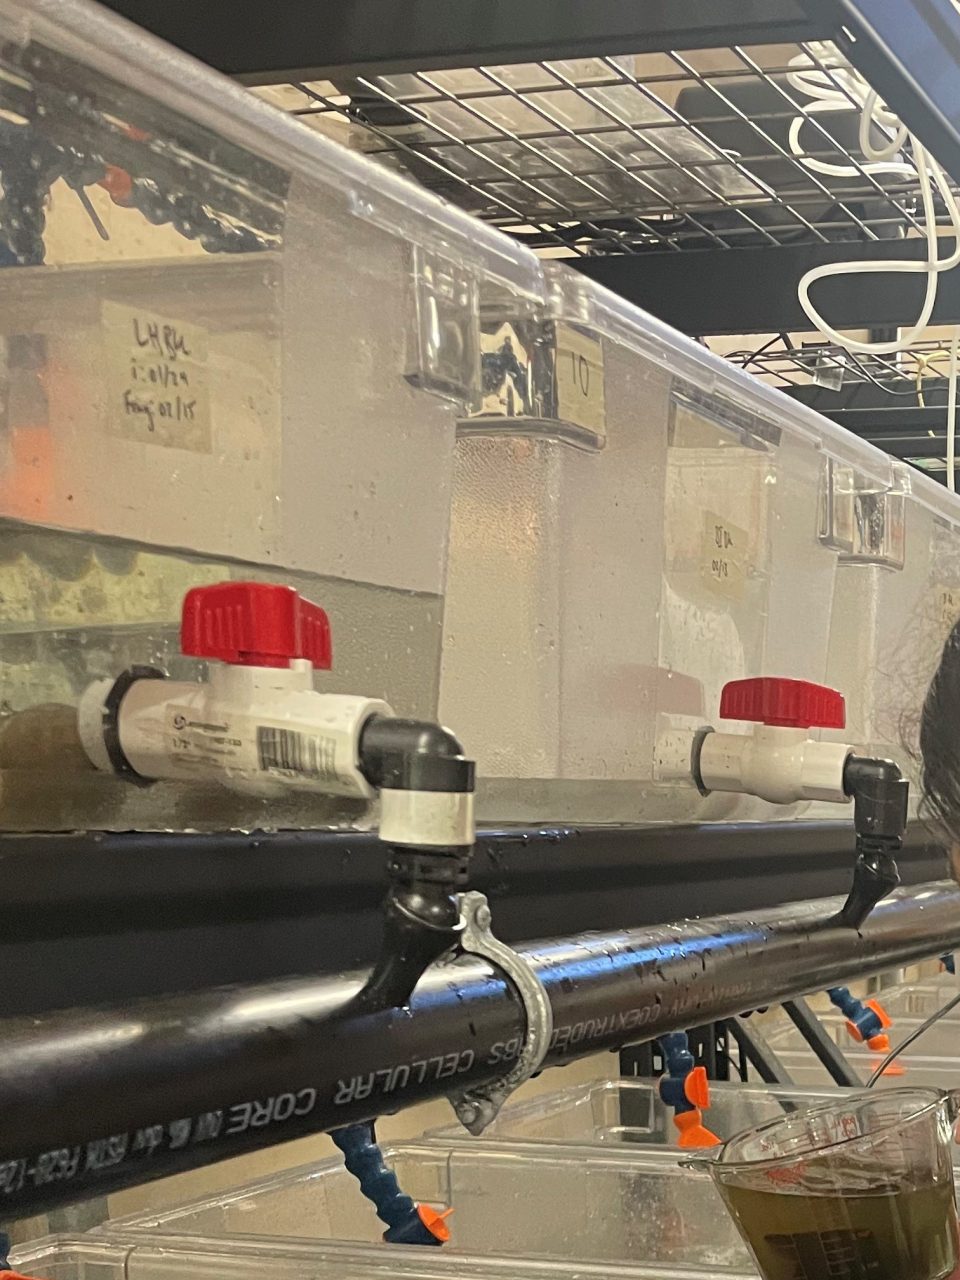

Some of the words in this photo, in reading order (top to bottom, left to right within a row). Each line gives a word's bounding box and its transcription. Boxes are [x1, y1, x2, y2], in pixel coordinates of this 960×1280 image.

[571, 351, 590, 397] 10
[334, 1049, 474, 1105] CELLULAR
[225, 1088, 317, 1134] CORE
